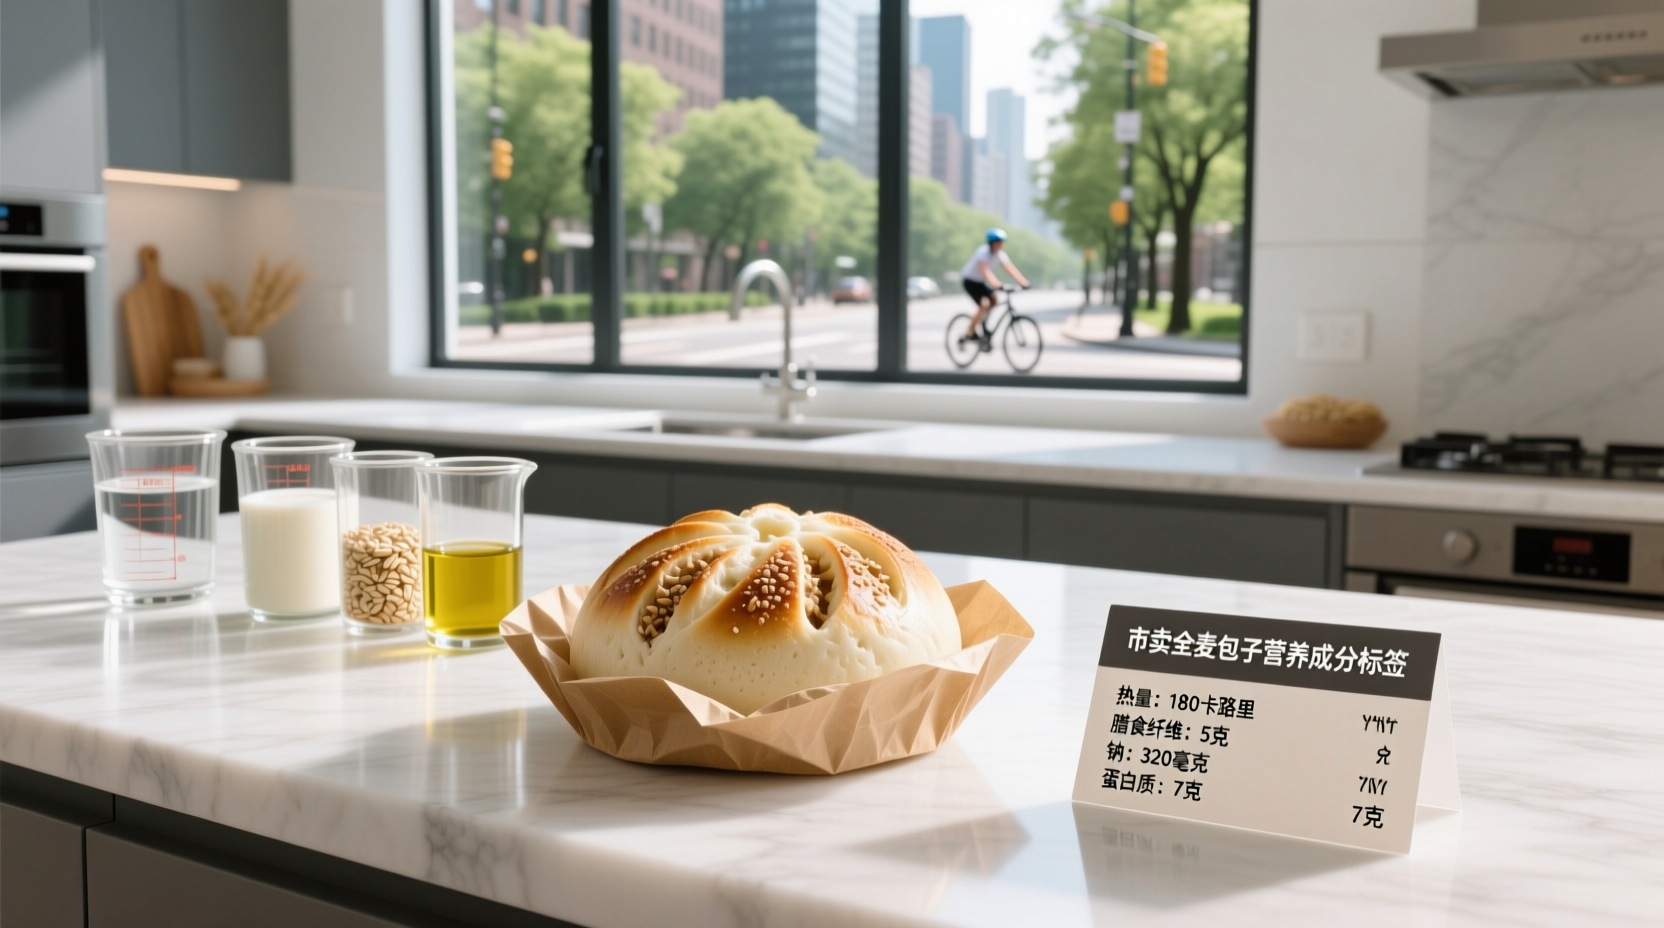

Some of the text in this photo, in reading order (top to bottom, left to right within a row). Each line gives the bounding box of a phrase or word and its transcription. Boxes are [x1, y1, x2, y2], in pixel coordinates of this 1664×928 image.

[1128, 626, 1410, 677] 市卖全麦包子营养成分标签
[1101, 767, 1203, 802] 蛋白质：7克
[1352, 805, 1385, 829] 7克
